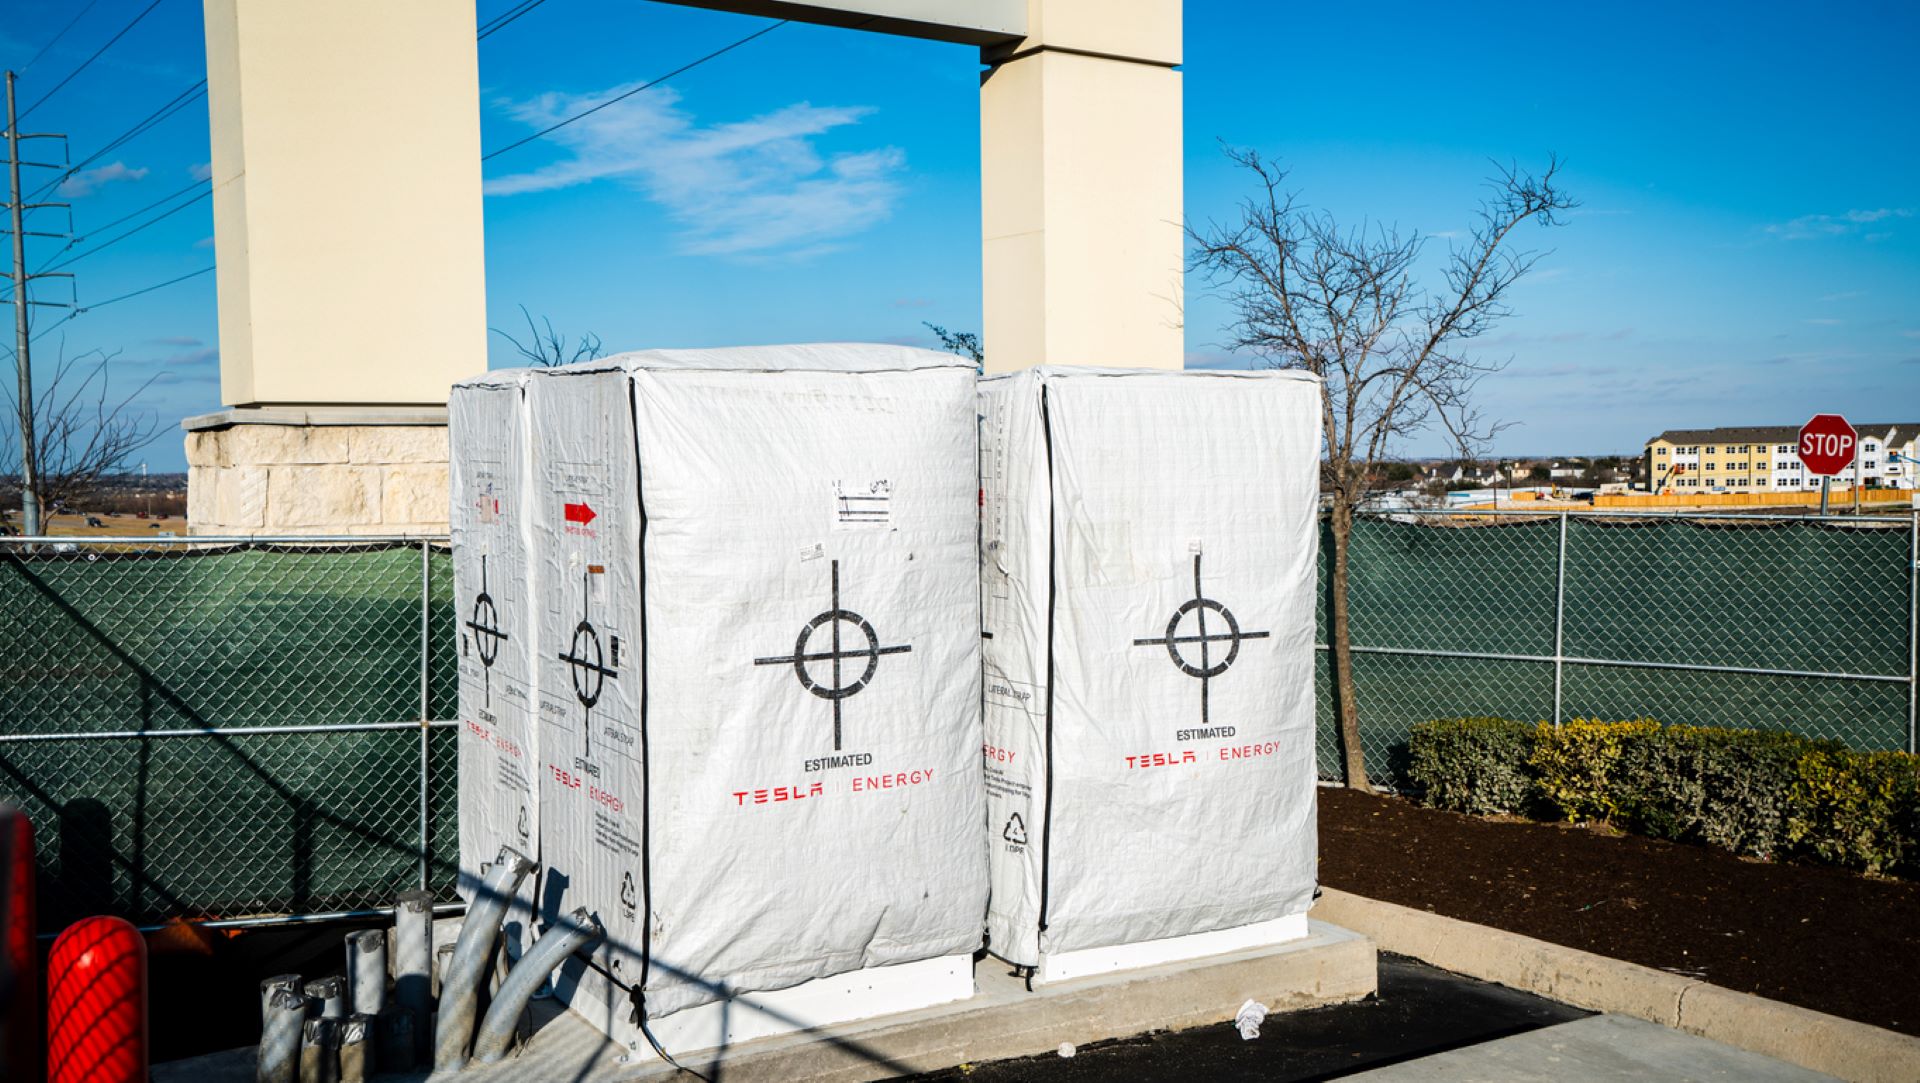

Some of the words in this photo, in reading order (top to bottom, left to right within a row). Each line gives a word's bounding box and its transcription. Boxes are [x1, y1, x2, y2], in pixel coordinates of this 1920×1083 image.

[1802, 433, 1853, 457] STOP
[1176, 726, 1236, 741] ESTIMATED
[804, 752, 873, 772] ESTIMATED
[1125, 751, 1197, 769] TESLA
[1220, 741, 1281, 760] ENERGY
[549, 763, 581, 789] TESLA
[589, 785, 625, 814] ENERGY
[732, 782, 823, 806] TESLA
[852, 768, 934, 792] ENERGY
